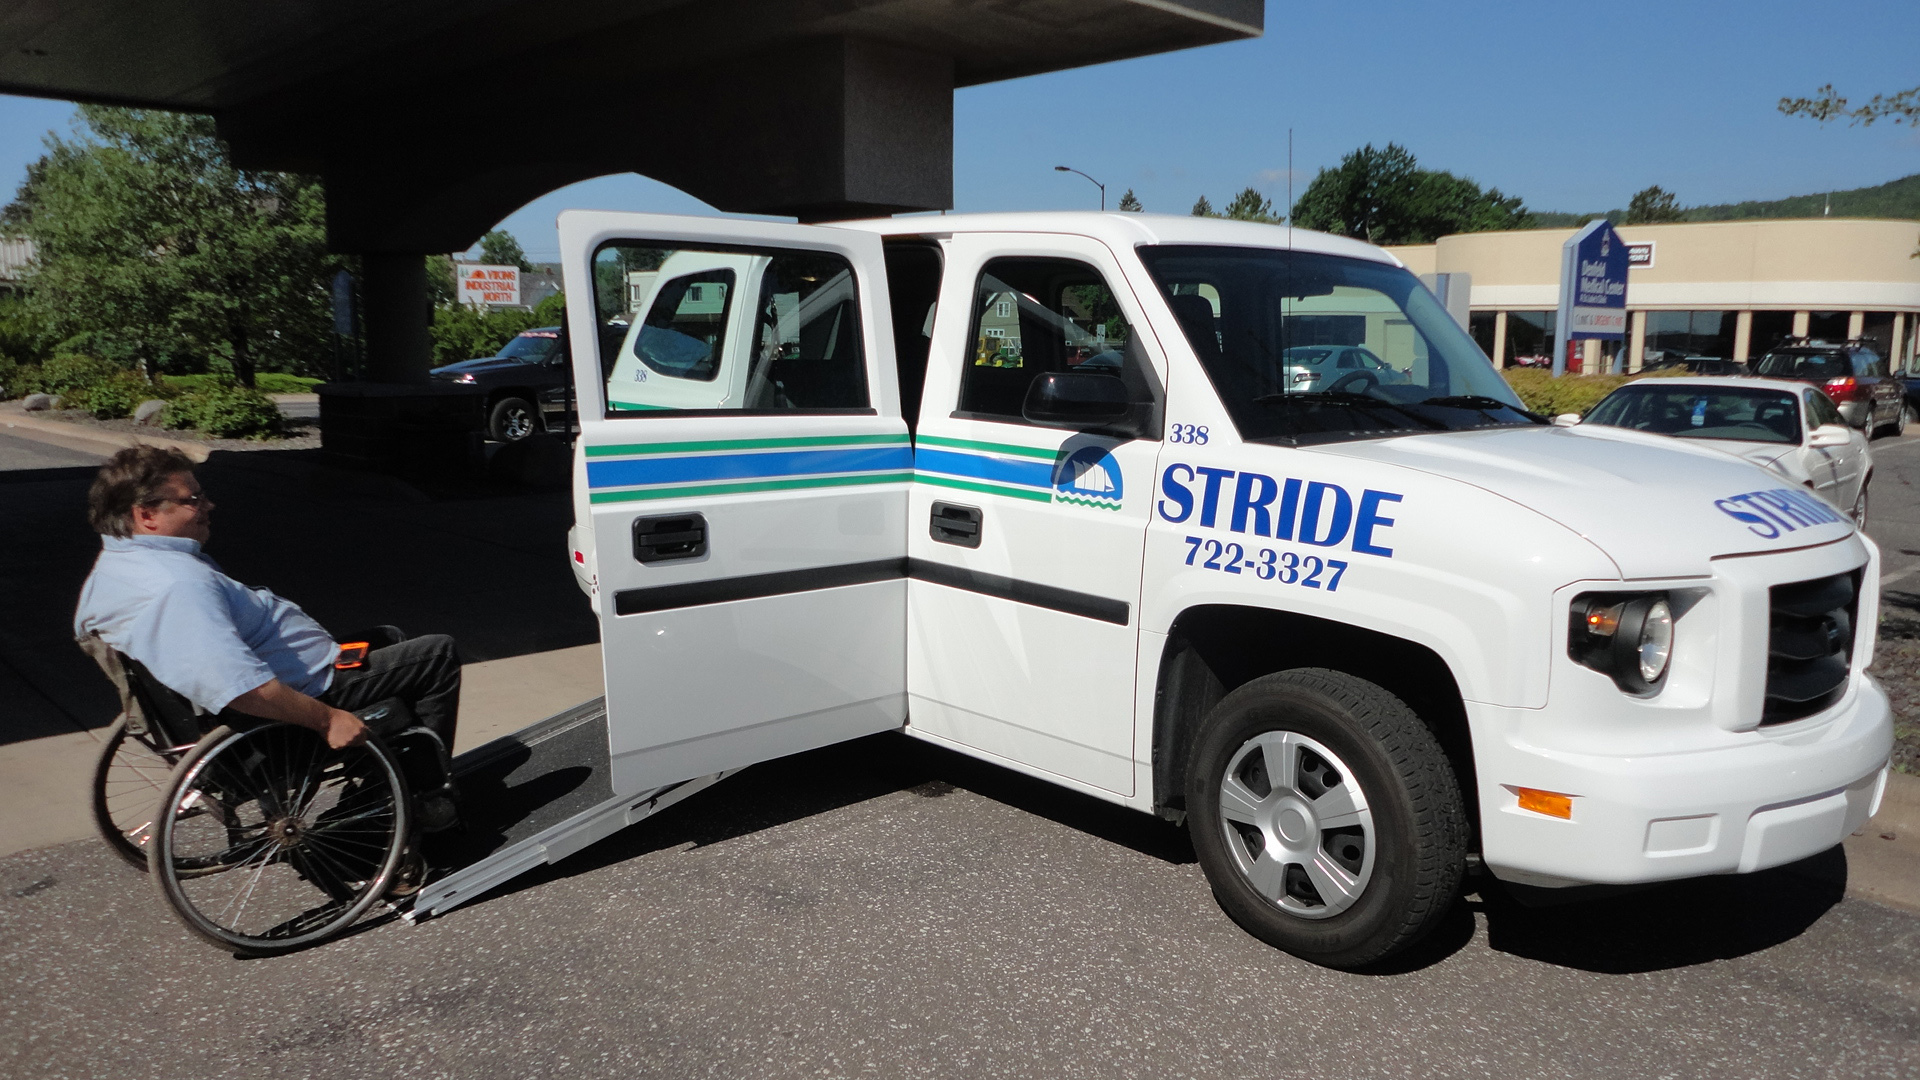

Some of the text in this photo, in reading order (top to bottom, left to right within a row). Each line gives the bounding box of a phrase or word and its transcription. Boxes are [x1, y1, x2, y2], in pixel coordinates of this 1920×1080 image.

[487, 269, 516, 280] VIKING
[465, 280, 517, 292] INDUSTRIAL
[1580, 277, 1625, 296] Medical Center
[483, 292, 512, 302] NORTH
[1169, 423, 1210, 445] 338
[1158, 463, 1404, 558] STRIDE
[1184, 536, 1348, 592] 722-3327
